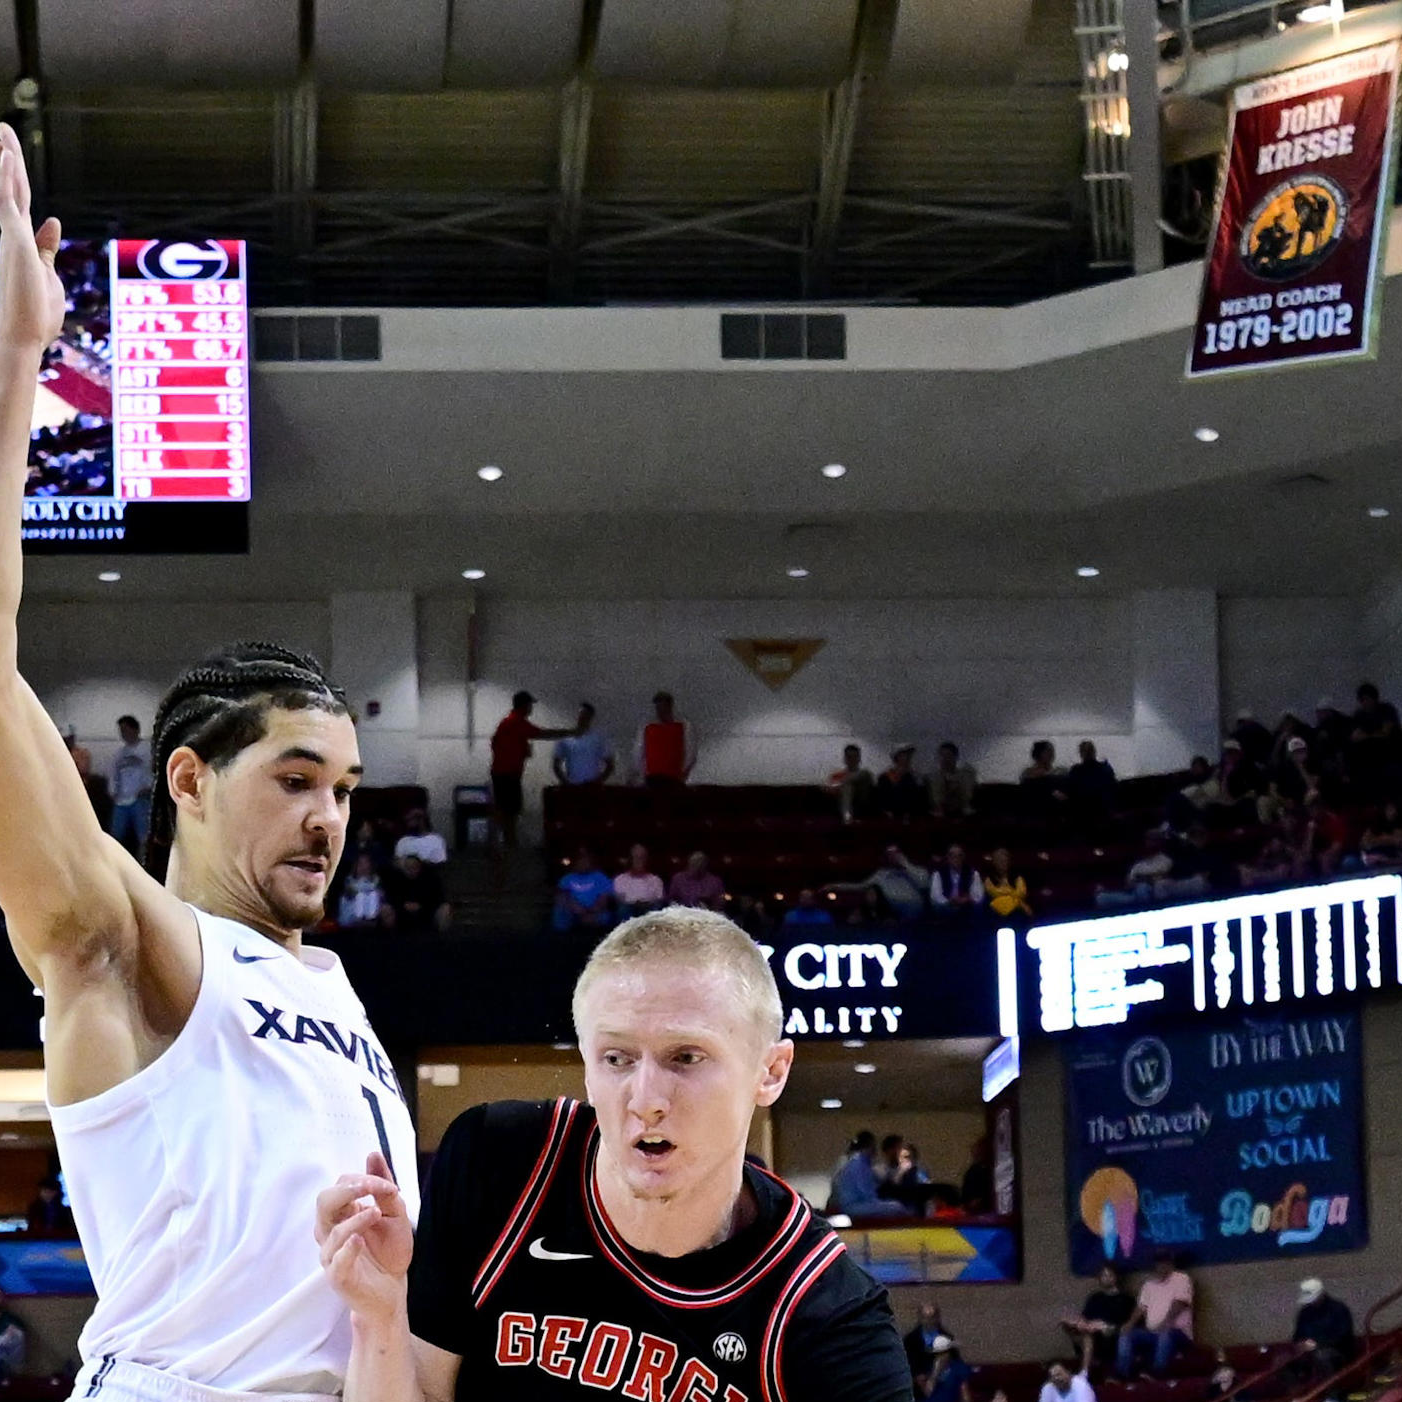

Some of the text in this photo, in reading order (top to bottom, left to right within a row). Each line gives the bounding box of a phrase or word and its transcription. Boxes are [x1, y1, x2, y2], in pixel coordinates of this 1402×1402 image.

[1276, 96, 1344, 138] JOHN
[1256, 124, 1355, 176] KRESSE
[1220, 284, 1342, 316] HEAD COACH
[1202, 303, 1353, 354] 1979-2002
[120, 368, 161, 387] AST
[216, 396, 242, 414] 15
[121, 423, 243, 442] STL 3
[228, 450, 244, 469] 3
[228, 477, 245, 496] 3
[76, 502, 127, 521] CITY
[784, 943, 908, 990] CITY
[1209, 1032, 1243, 1068] BY
[1289, 1018, 1350, 1058] WAY
[1226, 1081, 1341, 1118] UPTOWN
[361, 1084, 401, 1191] 1
[1087, 1103, 1214, 1144] The Waverly
[1239, 1136, 1331, 1171] SOCIAL
[715, 1335, 746, 1360] SEC
